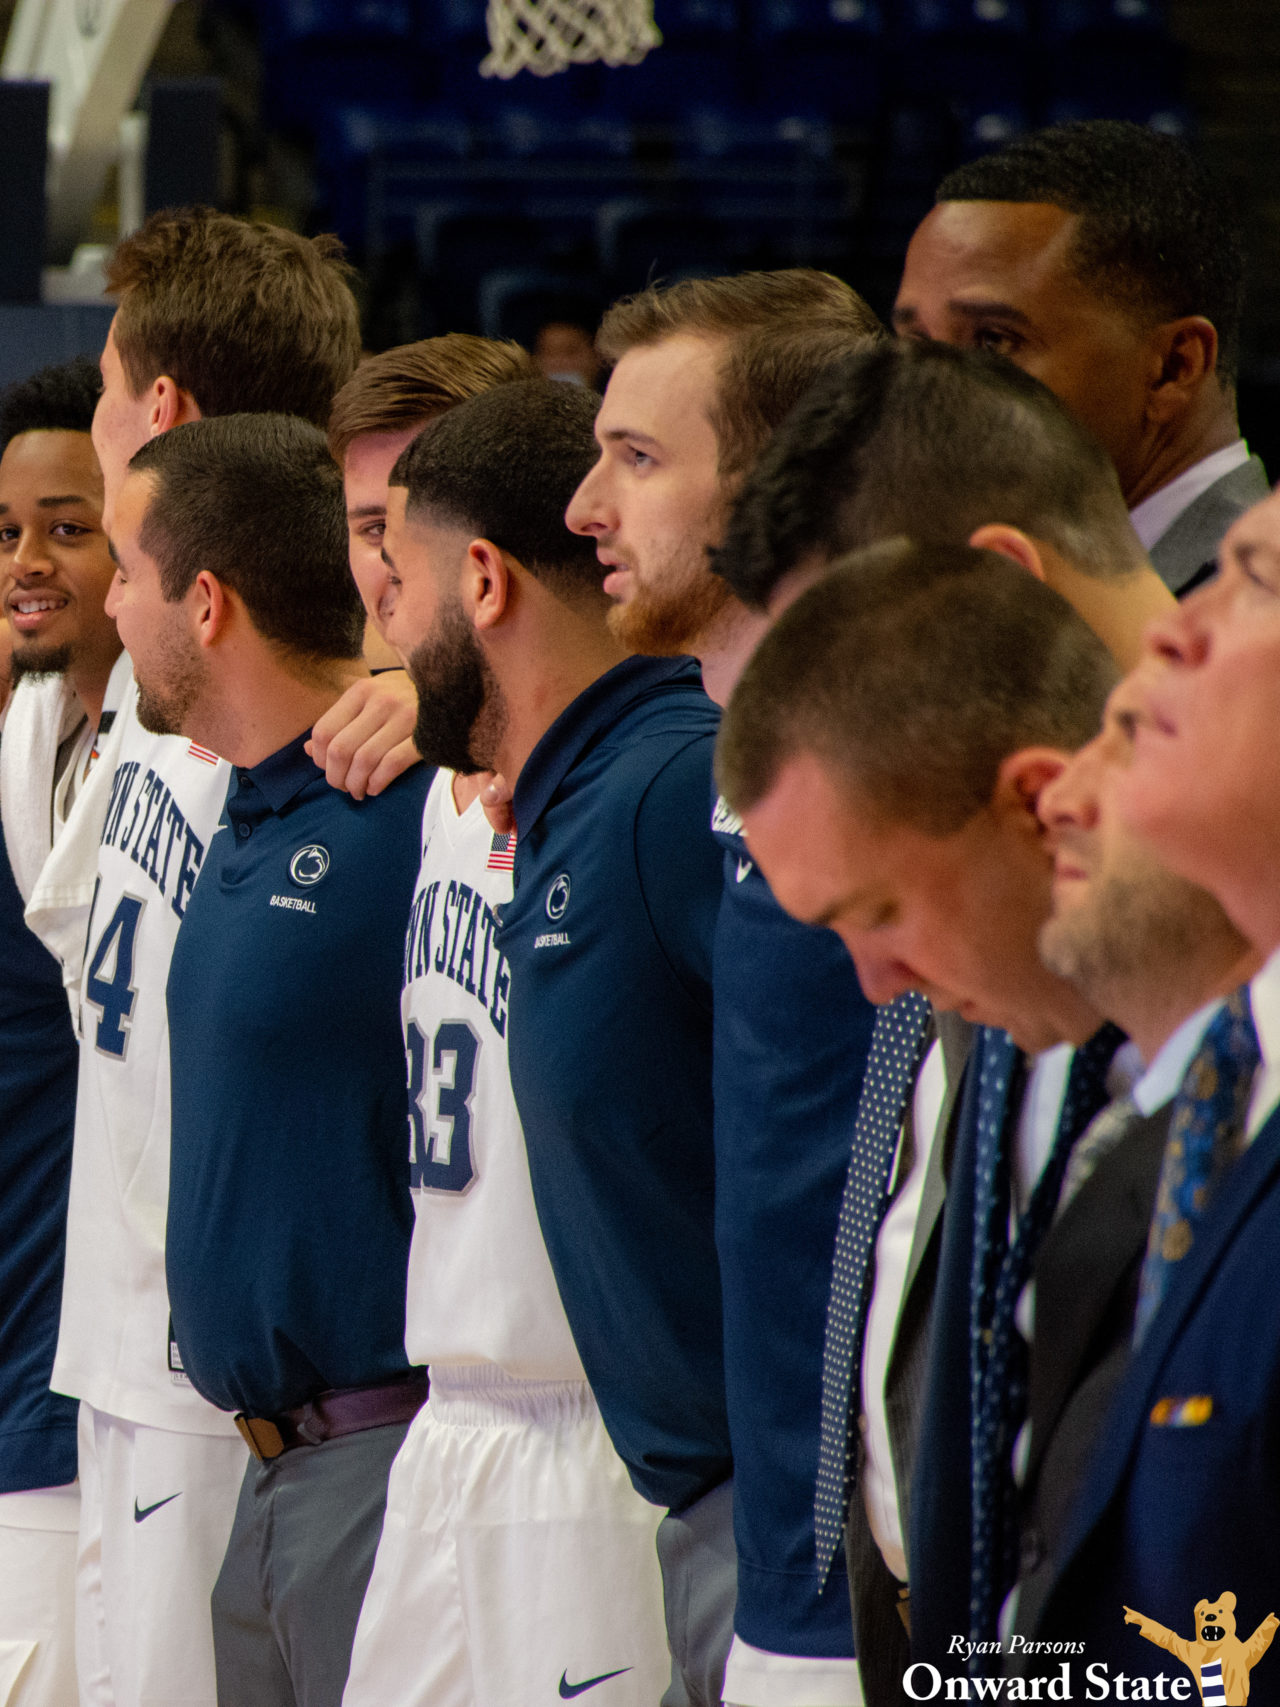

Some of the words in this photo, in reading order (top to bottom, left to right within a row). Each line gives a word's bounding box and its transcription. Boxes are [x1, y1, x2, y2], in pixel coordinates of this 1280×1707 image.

[120, 767, 205, 921] STATE
[269, 894, 318, 914] BASKETBALL
[434, 879, 511, 1041] STATE
[406, 1017, 483, 1198] 33
